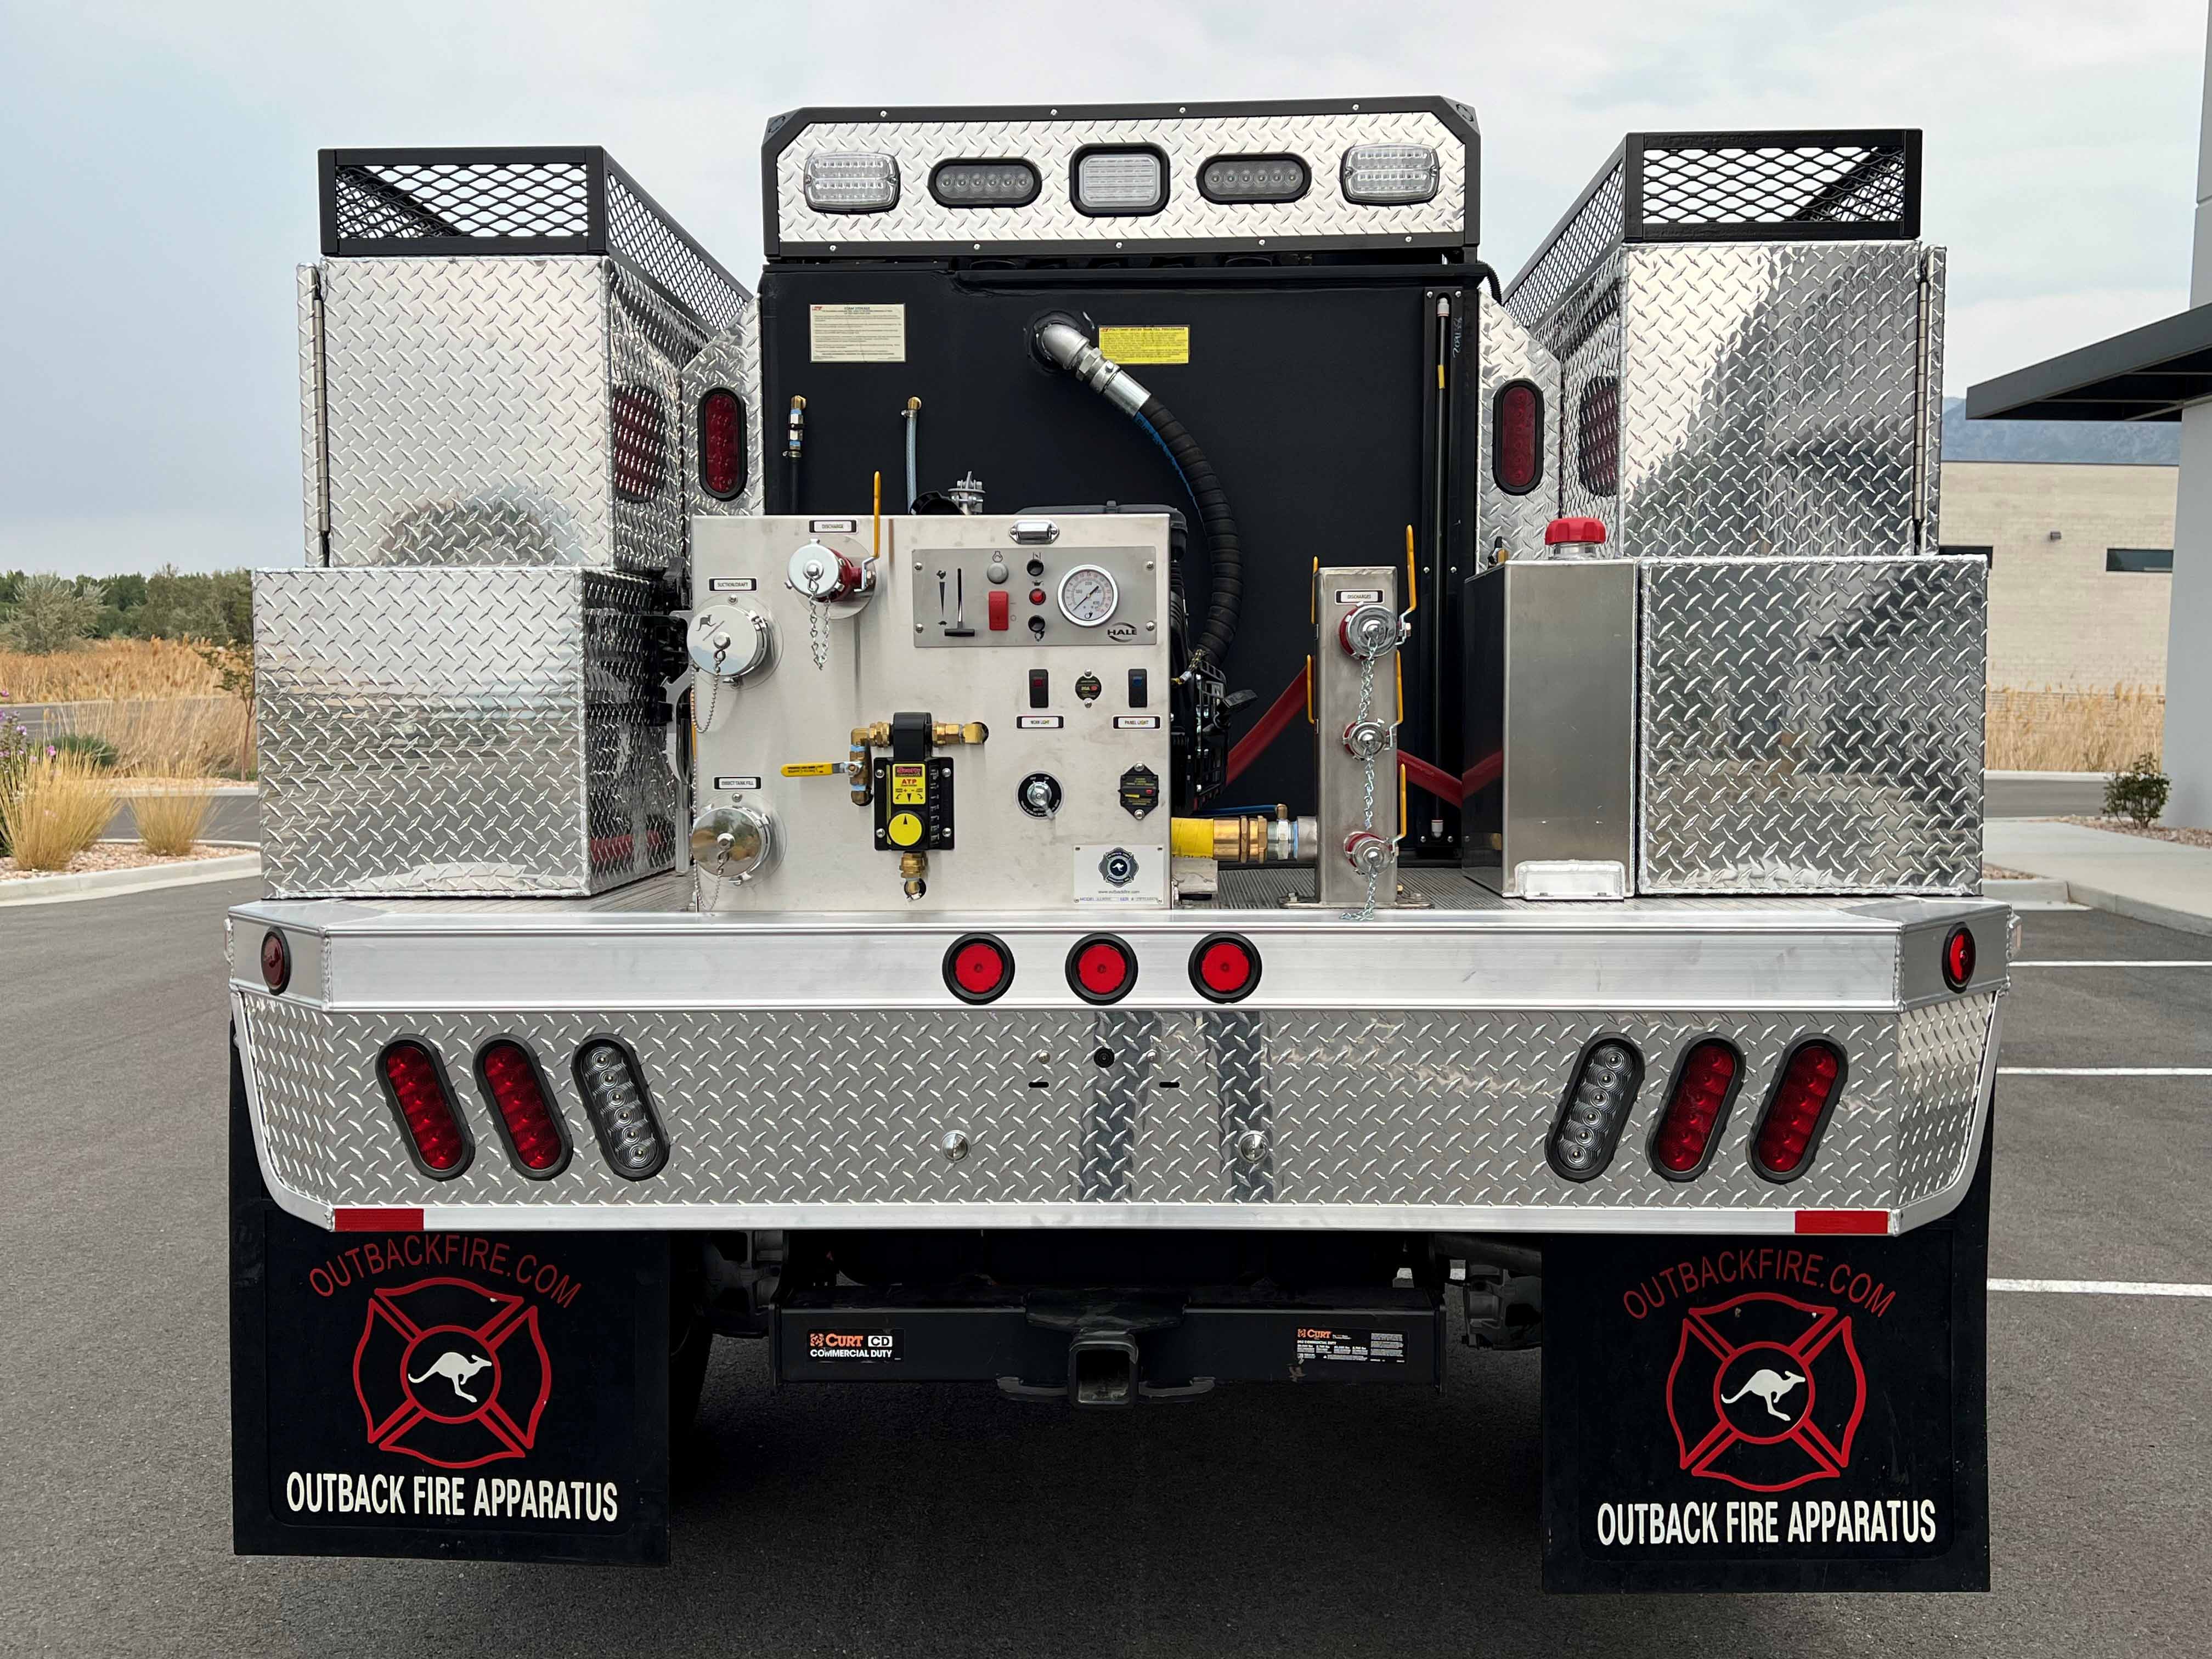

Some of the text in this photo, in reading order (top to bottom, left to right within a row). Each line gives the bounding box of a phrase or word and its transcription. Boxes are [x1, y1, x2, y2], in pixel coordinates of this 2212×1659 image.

[309, 1234, 582, 1309] OUTBACKFIRE.COM
[1623, 1249, 1897, 1319] OUTBACKFIRE.COM
[810, 1349, 892, 1358] COMMERCIAL DUTY
[825, 1333, 890, 1347] CURT CD
[1307, 1329, 1331, 1339] CURT
[286, 1471, 618, 1521] OUTBACK FIRE APPARATUS
[1597, 1499, 1937, 1546] OUTBACK FIRE APPARATUS
